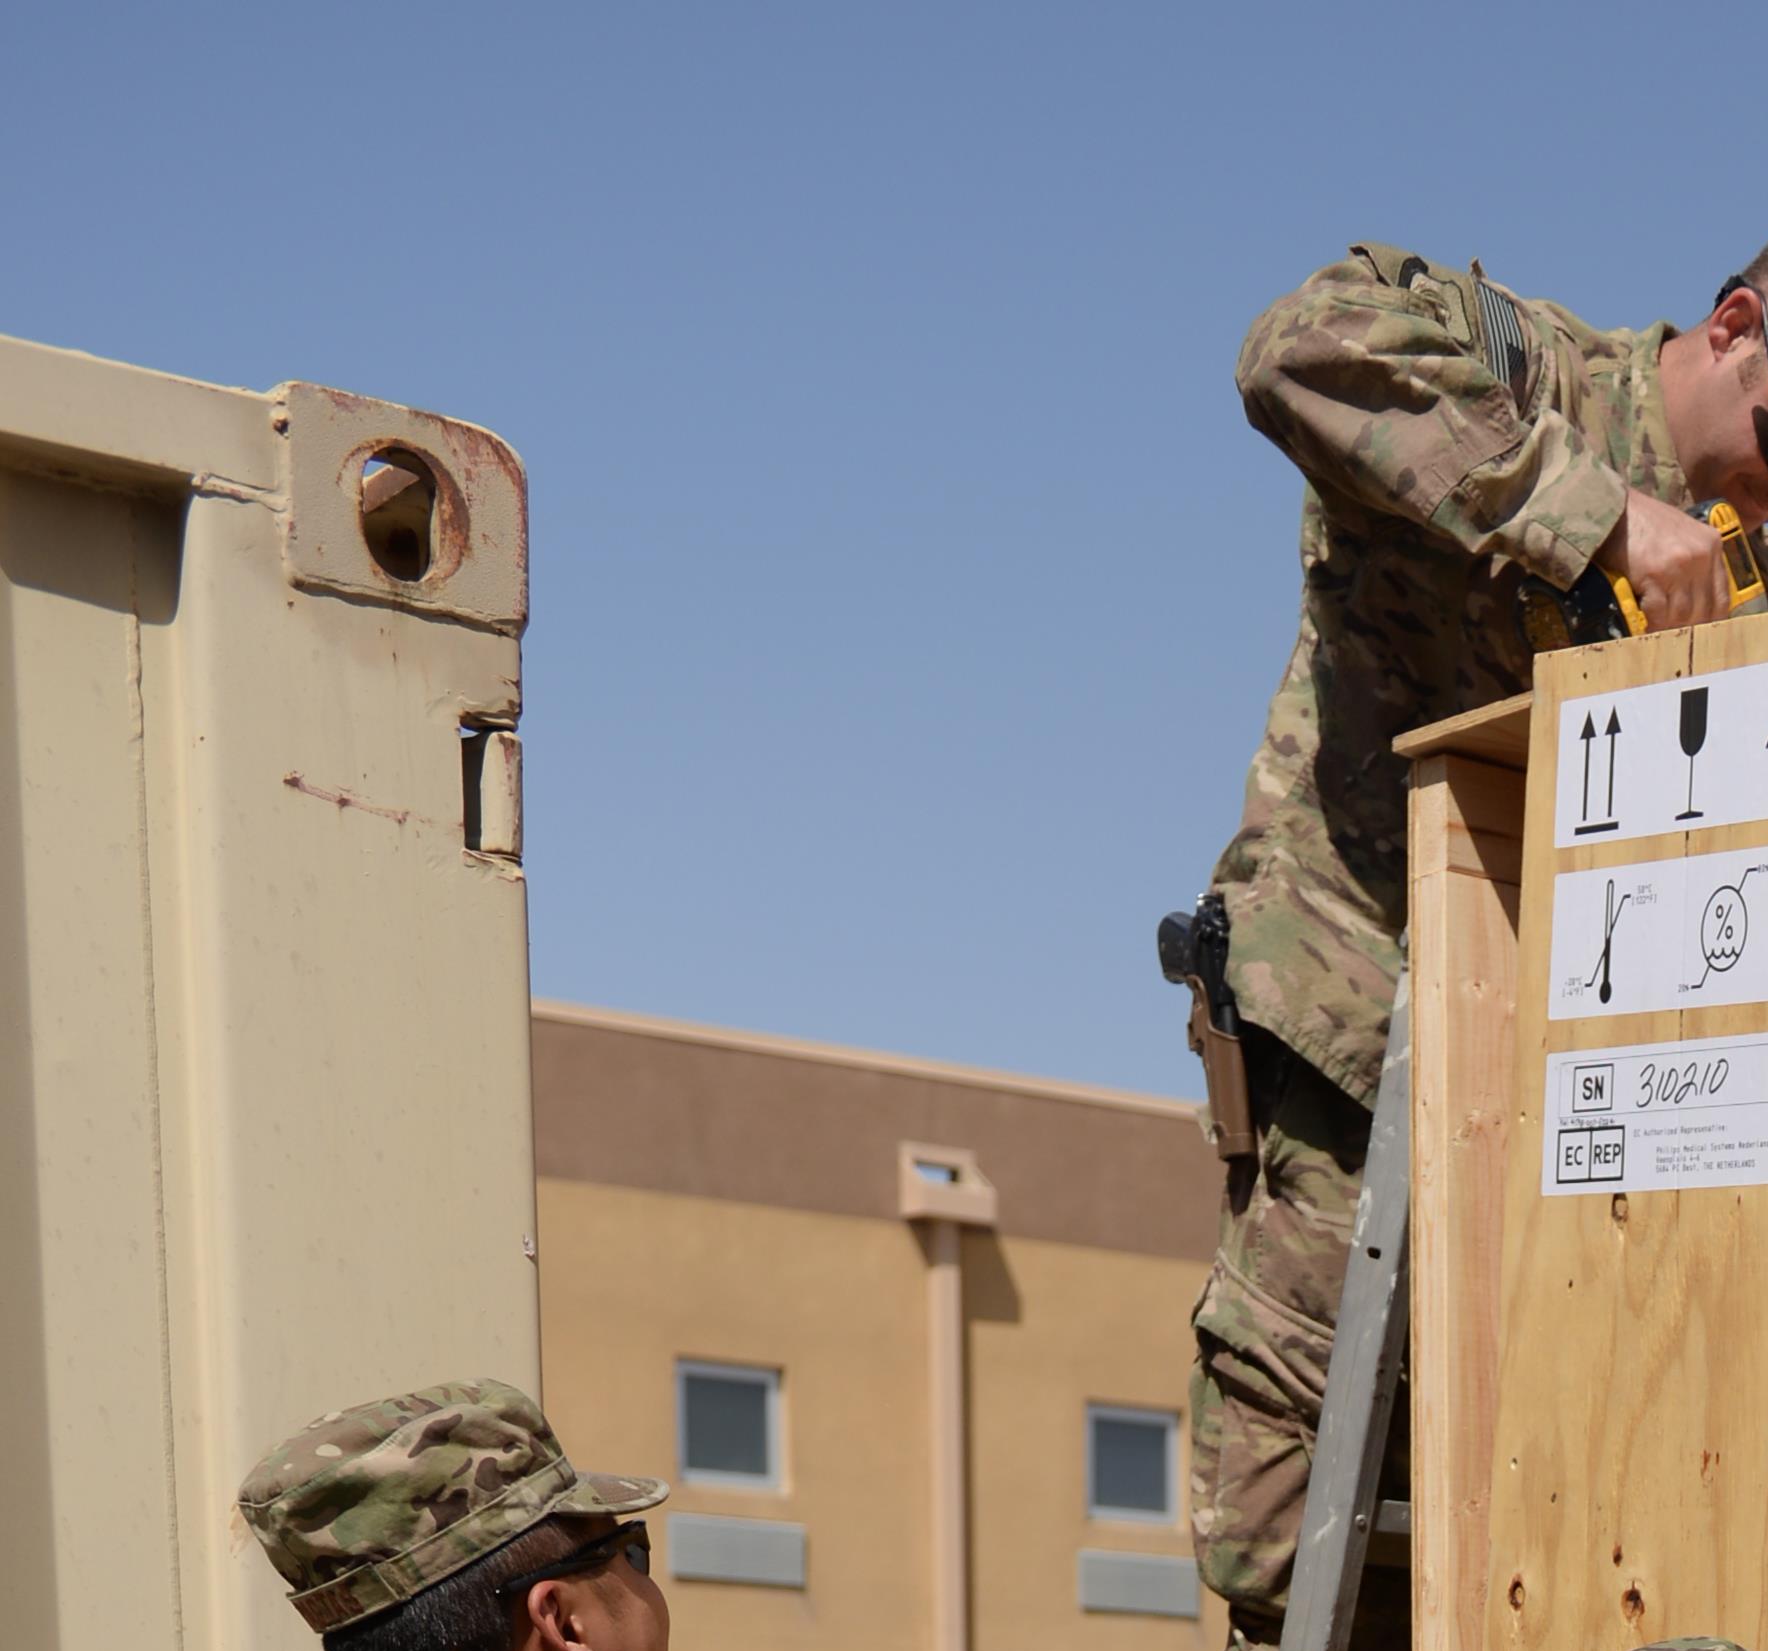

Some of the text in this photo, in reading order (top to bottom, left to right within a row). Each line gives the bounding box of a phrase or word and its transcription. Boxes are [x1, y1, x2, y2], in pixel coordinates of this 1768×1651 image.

[1582, 1075, 1604, 1101] SN
[1636, 1058, 1729, 1108] 310210
[1565, 1143, 1621, 1167] EC REP
